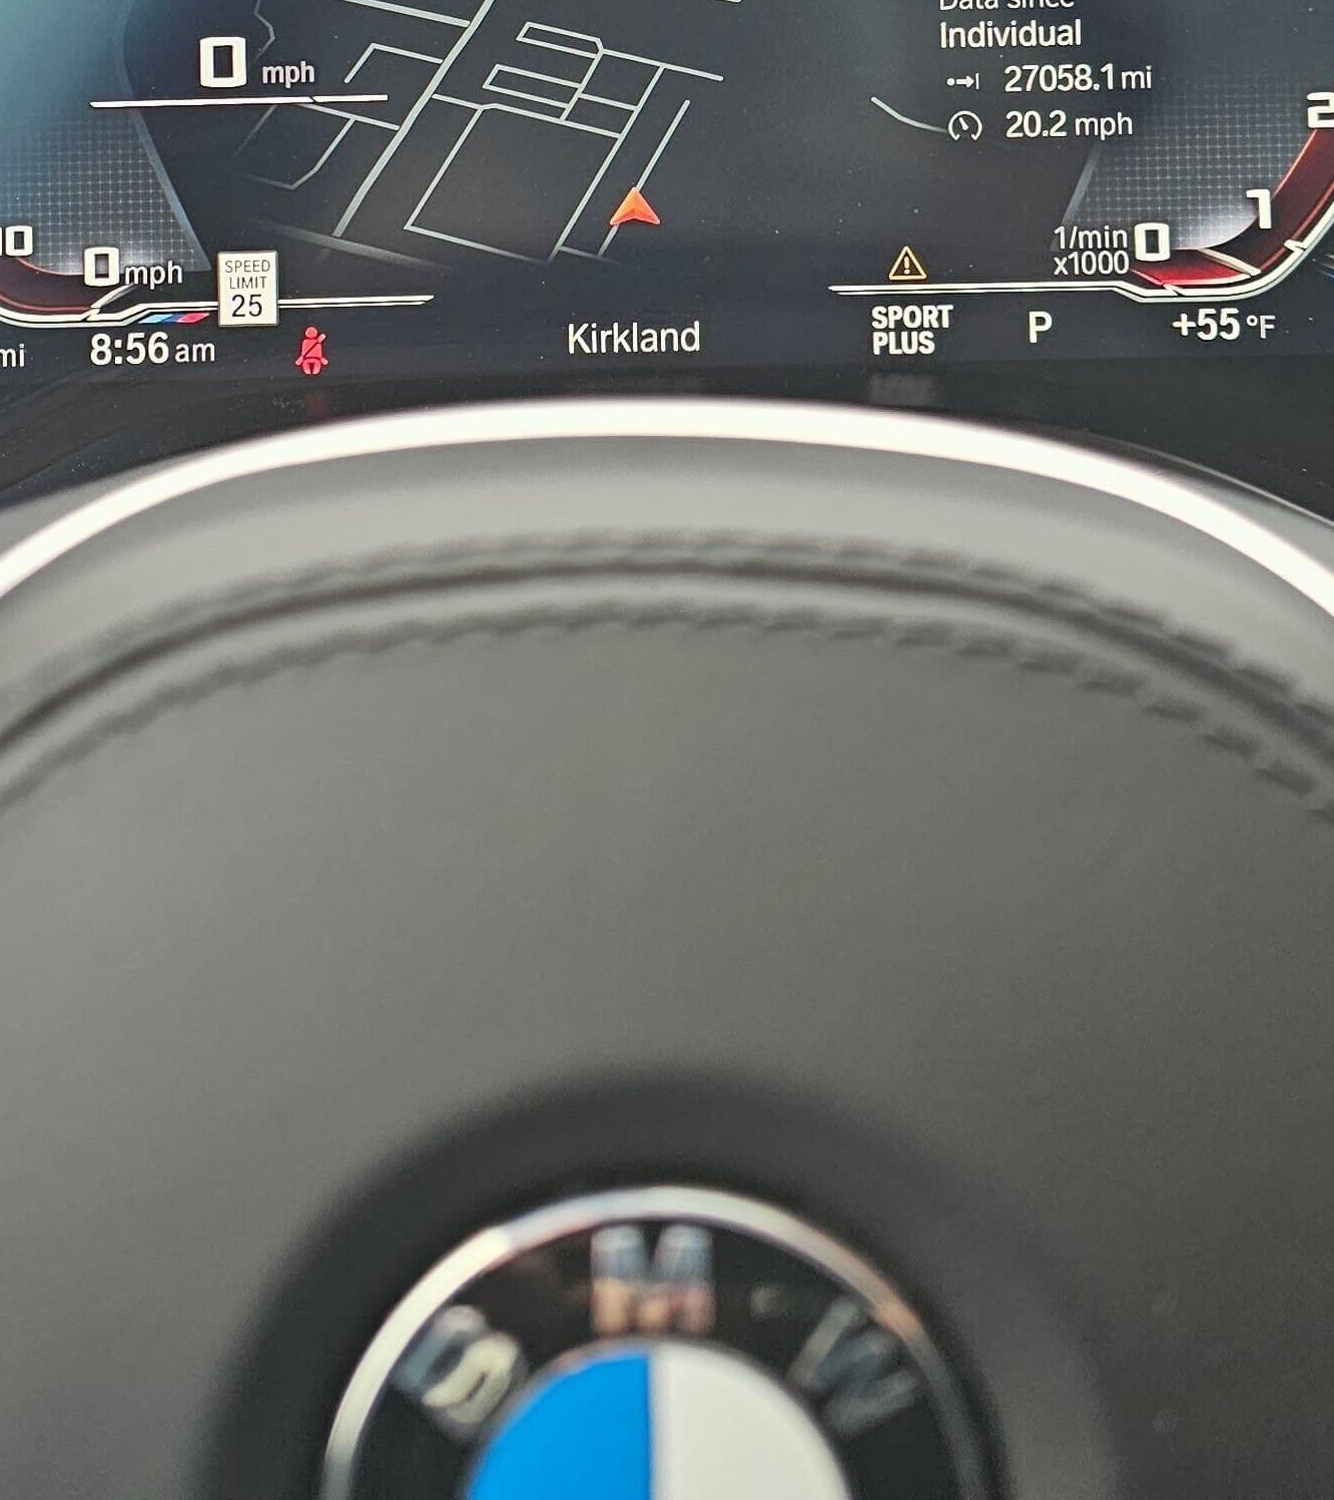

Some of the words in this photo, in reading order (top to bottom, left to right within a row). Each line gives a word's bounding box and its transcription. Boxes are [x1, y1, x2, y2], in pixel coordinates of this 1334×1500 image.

[939, 18, 1082, 49] Individual
[199, 36, 247, 88] 0
[261, 60, 316, 89] mph
[1003, 63, 1114, 93] 27058.1
[1121, 64, 1153, 90] mi
[1005, 109, 1068, 139] 20.2
[1074, 111, 1134, 141] mph
[1245, 188, 1272, 230] 1
[1053, 224, 1129, 251] 1/min
[1133, 221, 1171, 263] 0
[83, 246, 121, 287] 0
[124, 260, 184, 290] mph
[224, 259, 272, 274] SPEED
[1053, 250, 1130, 276] x1000
[228, 275, 268, 290] LIMIT
[231, 294, 263, 318] 25
[871, 304, 954, 330] SPORT
[567, 320, 701, 355] Kirkland
[1028, 311, 1053, 343] P
[1172, 307, 1241, 341] +55
[90, 331, 170, 366] 8:56
[174, 341, 216, 363] am
[871, 330, 935, 355] PLUS
